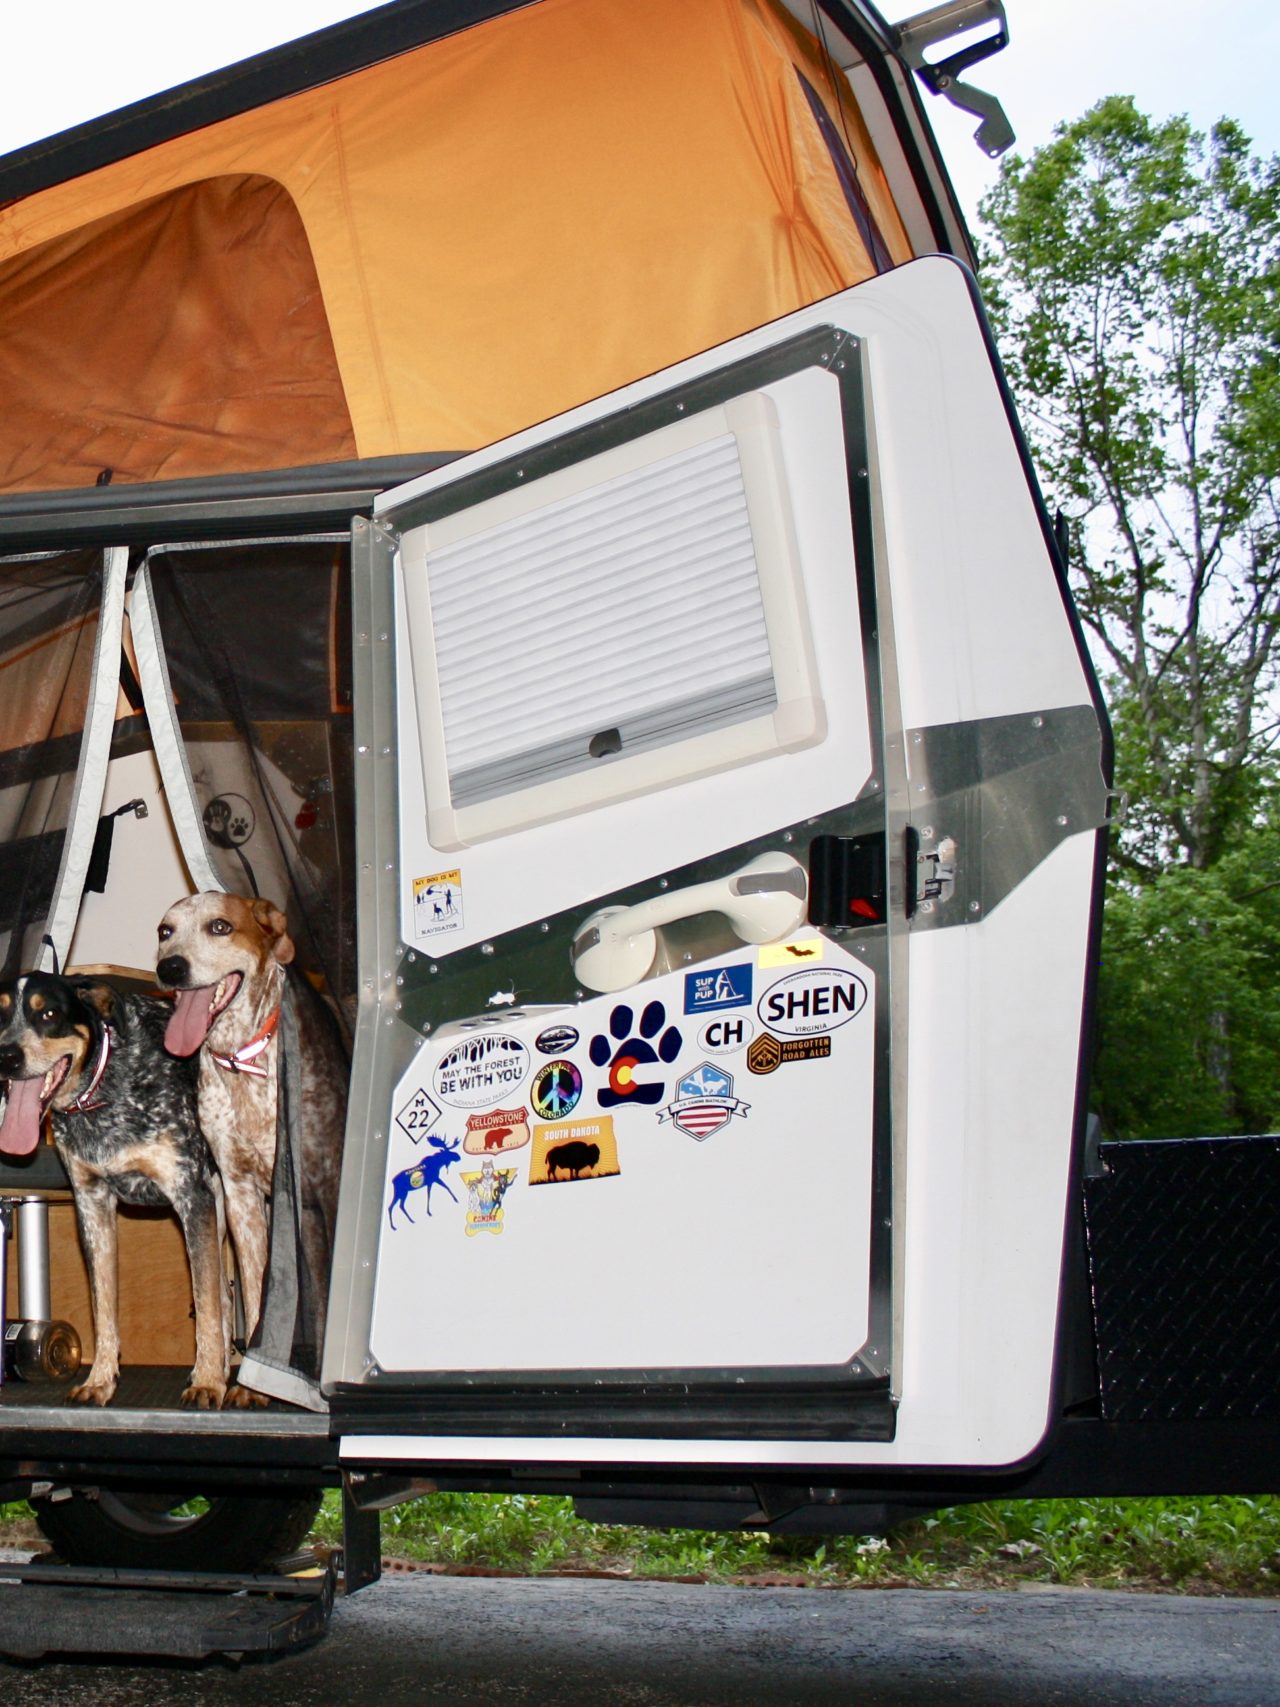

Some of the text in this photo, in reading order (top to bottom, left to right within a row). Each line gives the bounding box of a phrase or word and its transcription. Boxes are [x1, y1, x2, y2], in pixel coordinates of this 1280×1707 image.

[421, 922, 458, 935] NAVIGATOR
[695, 976, 714, 987] SUP
[694, 989, 714, 1001] PUP
[767, 983, 856, 1022] SHEN
[705, 1019, 743, 1047] CH
[794, 1022, 828, 1033] VIRGINIA
[782, 1037, 830, 1052] FORGOTTEN
[782, 1047, 830, 1061] ROAD ALES
[442, 1056, 521, 1080] MAY THE FOREST
[440, 1067, 523, 1095] BE WITH YOU
[415, 1098, 425, 1107] M
[538, 1101, 575, 1119] COLORADO
[407, 1109, 430, 1129] 22
[470, 1111, 524, 1128] YELLOWSTONE
[544, 1125, 600, 1141] SOUTH DAKOTA
